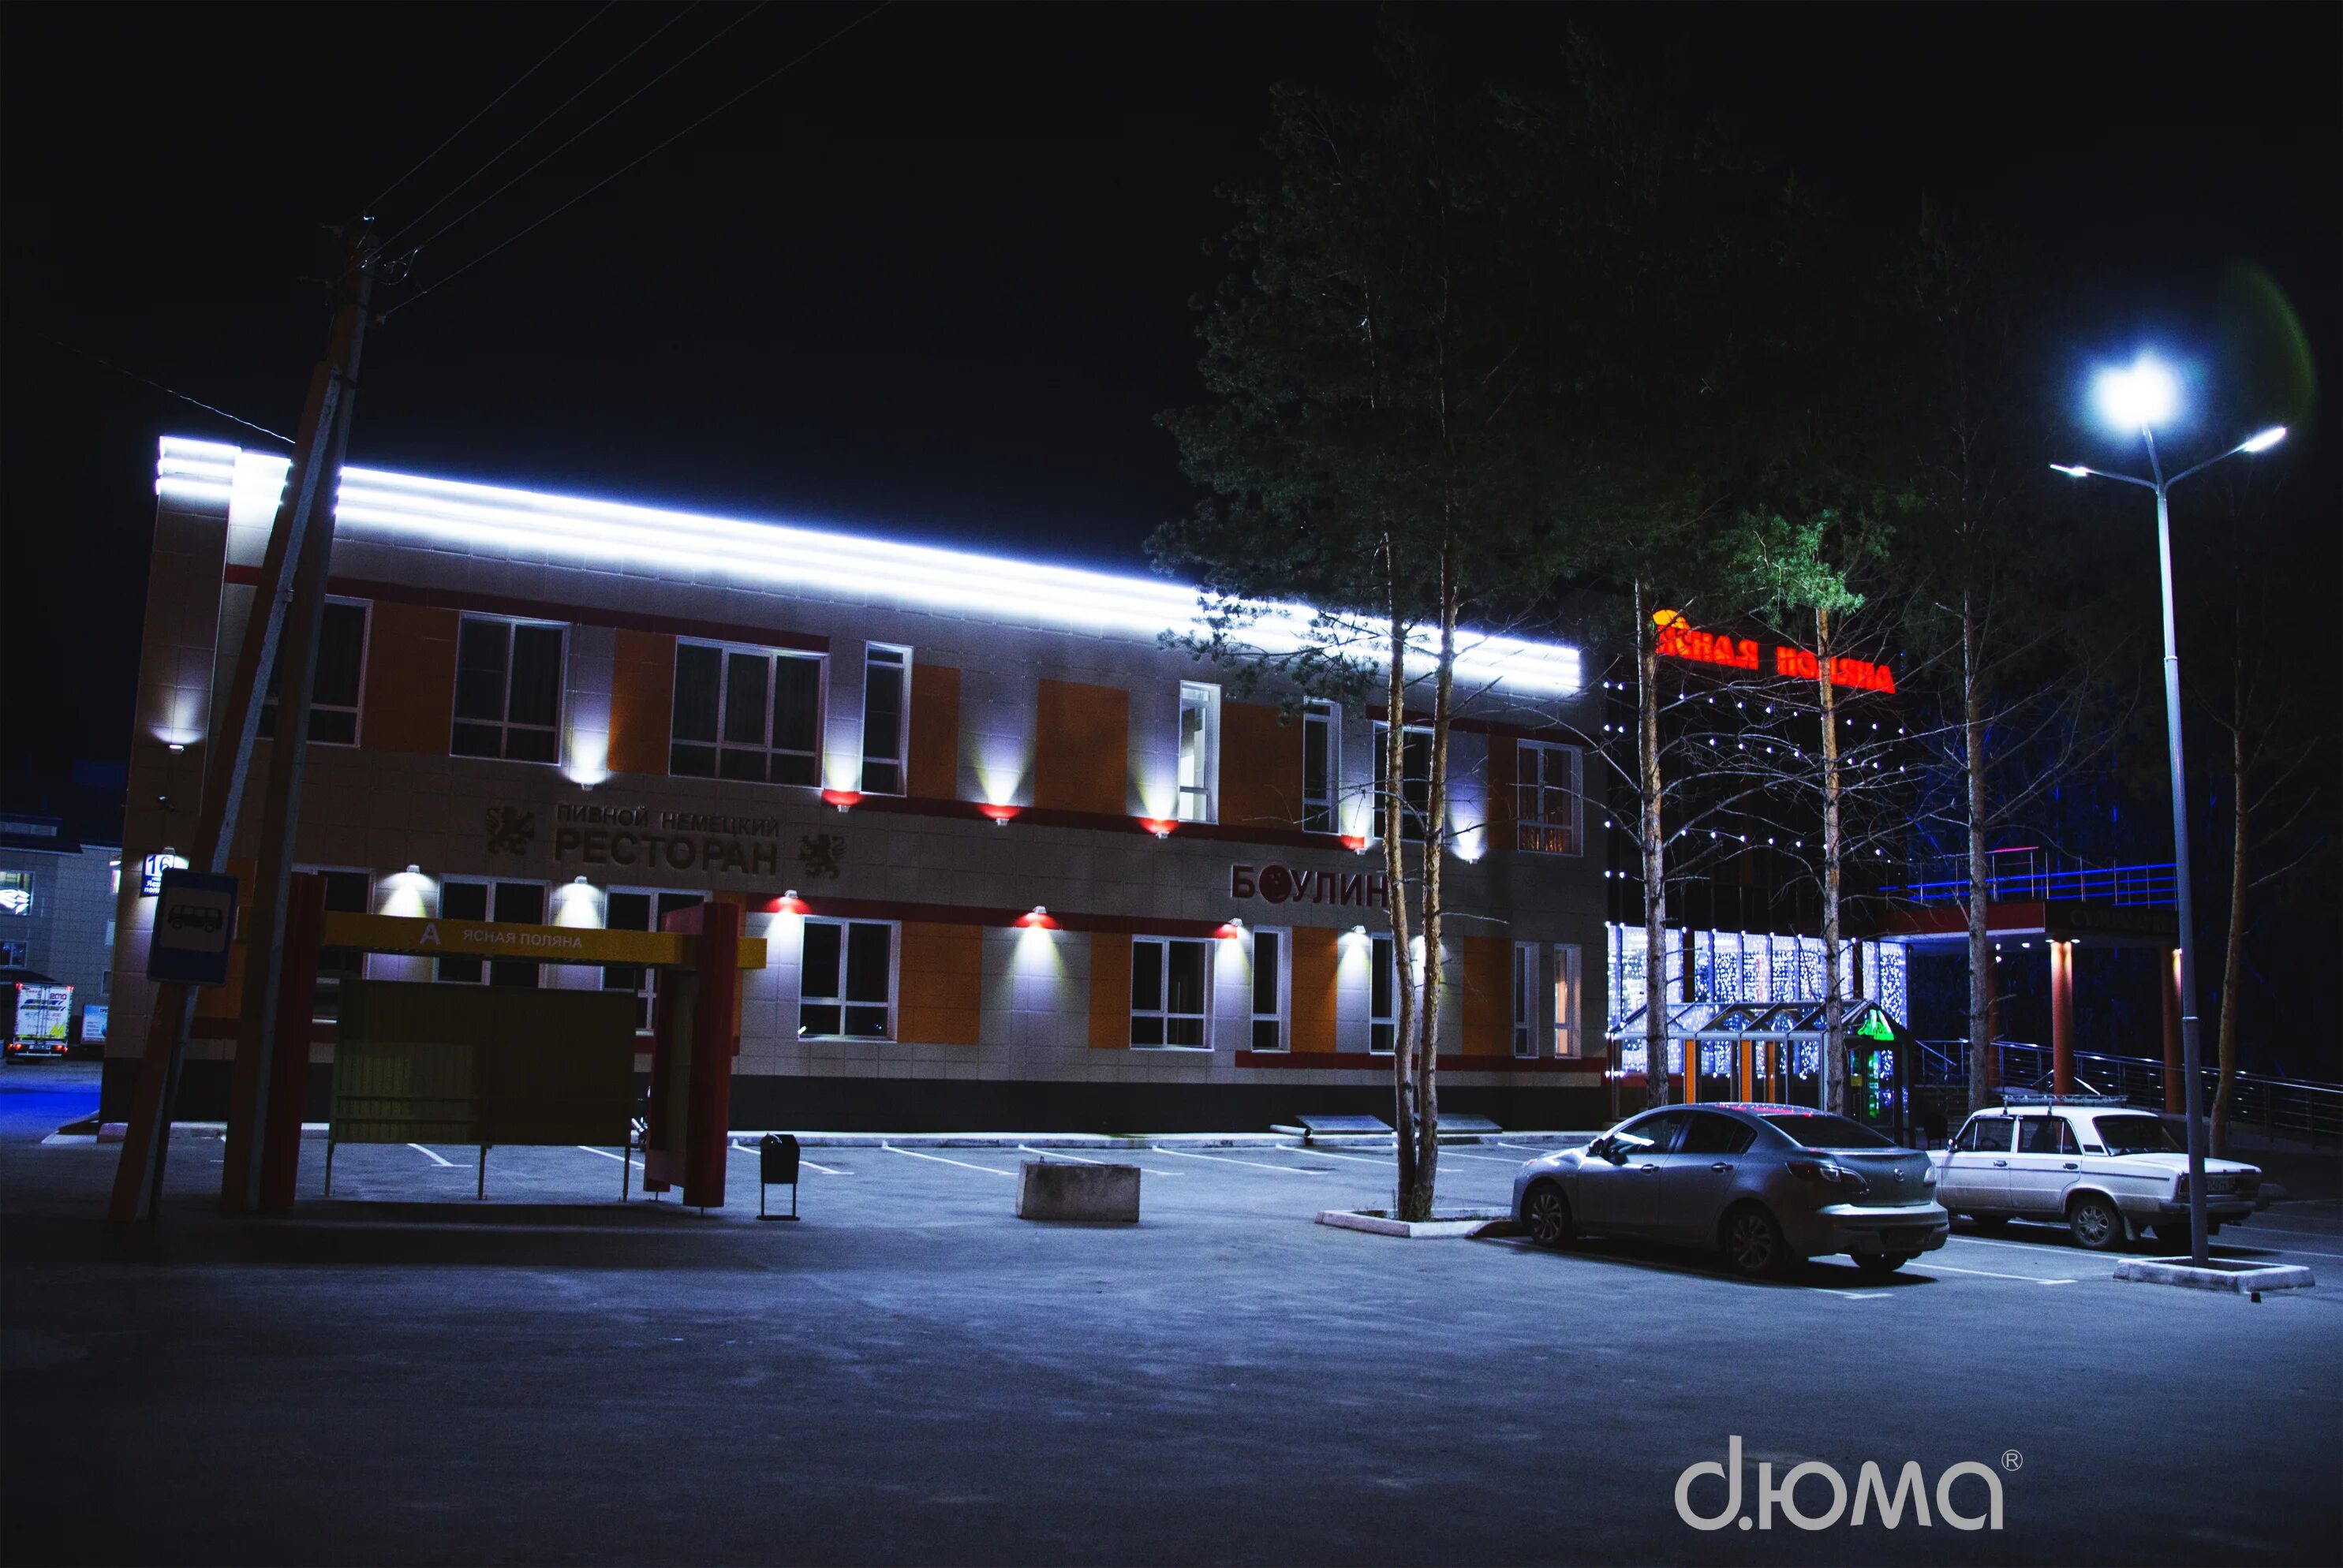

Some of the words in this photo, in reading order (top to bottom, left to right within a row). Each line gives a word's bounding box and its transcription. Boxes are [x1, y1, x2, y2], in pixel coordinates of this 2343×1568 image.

[1655, 625, 1758, 670] ЯСНАЯ
[556, 804, 648, 827] ПИВНОЙ
[660, 811, 780, 838] НЕМЕЦКИЙ
[148, 855, 170, 874] 16
[555, 828, 778, 875] РЕСТОРАН
[1231, 863, 1388, 907] БОУЛИН
[420, 921, 442, 945] А
[462, 928, 516, 943] ЯСНАЯ
[520, 934, 583, 949] ПОЛЯНА
